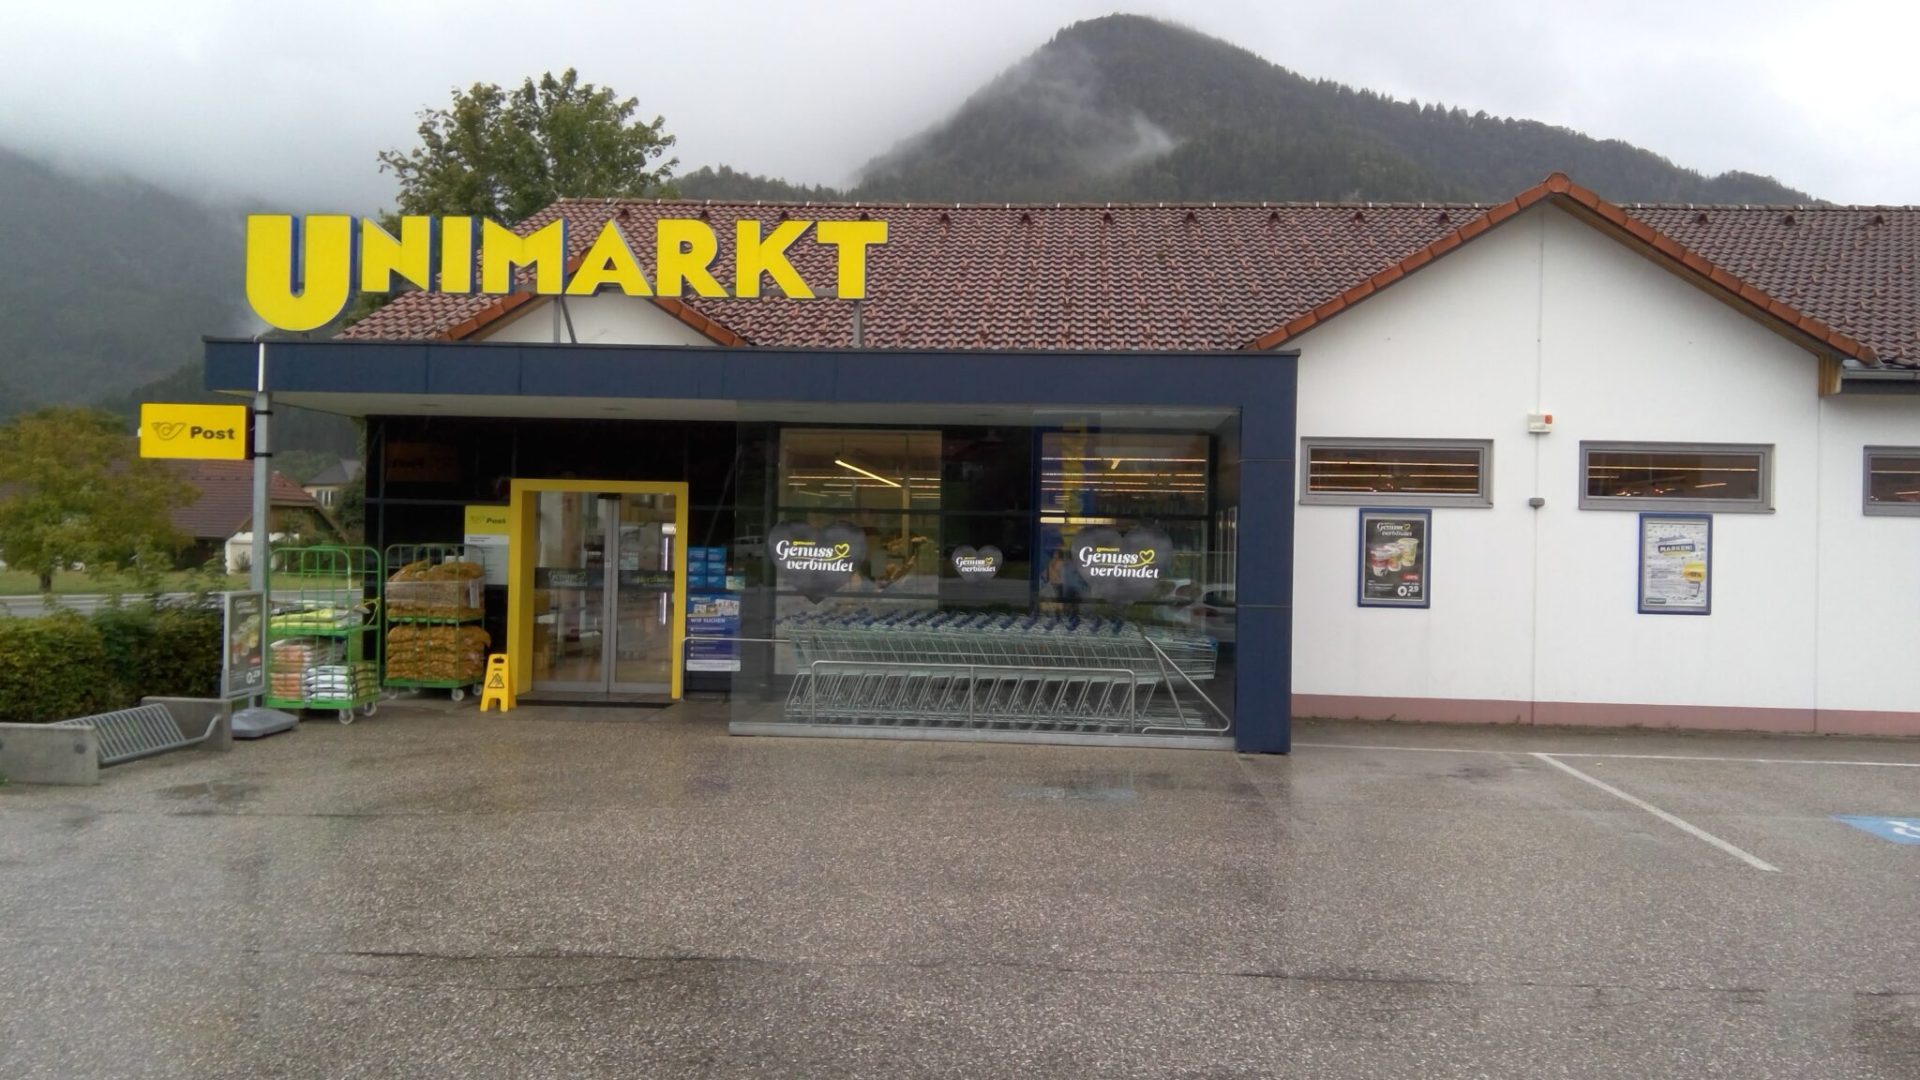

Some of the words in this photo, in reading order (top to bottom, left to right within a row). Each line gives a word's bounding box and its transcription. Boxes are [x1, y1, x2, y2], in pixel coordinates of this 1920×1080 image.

[246, 214, 889, 332] UNIMARKT
[190, 426, 235, 440] Post
[486, 517, 507, 525] Post
[775, 539, 834, 561] Genuss
[1079, 546, 1139, 568] Genuss
[786, 558, 855, 573] verbindet
[955, 556, 986, 568] Genuss
[1089, 564, 1160, 579] verbindet
